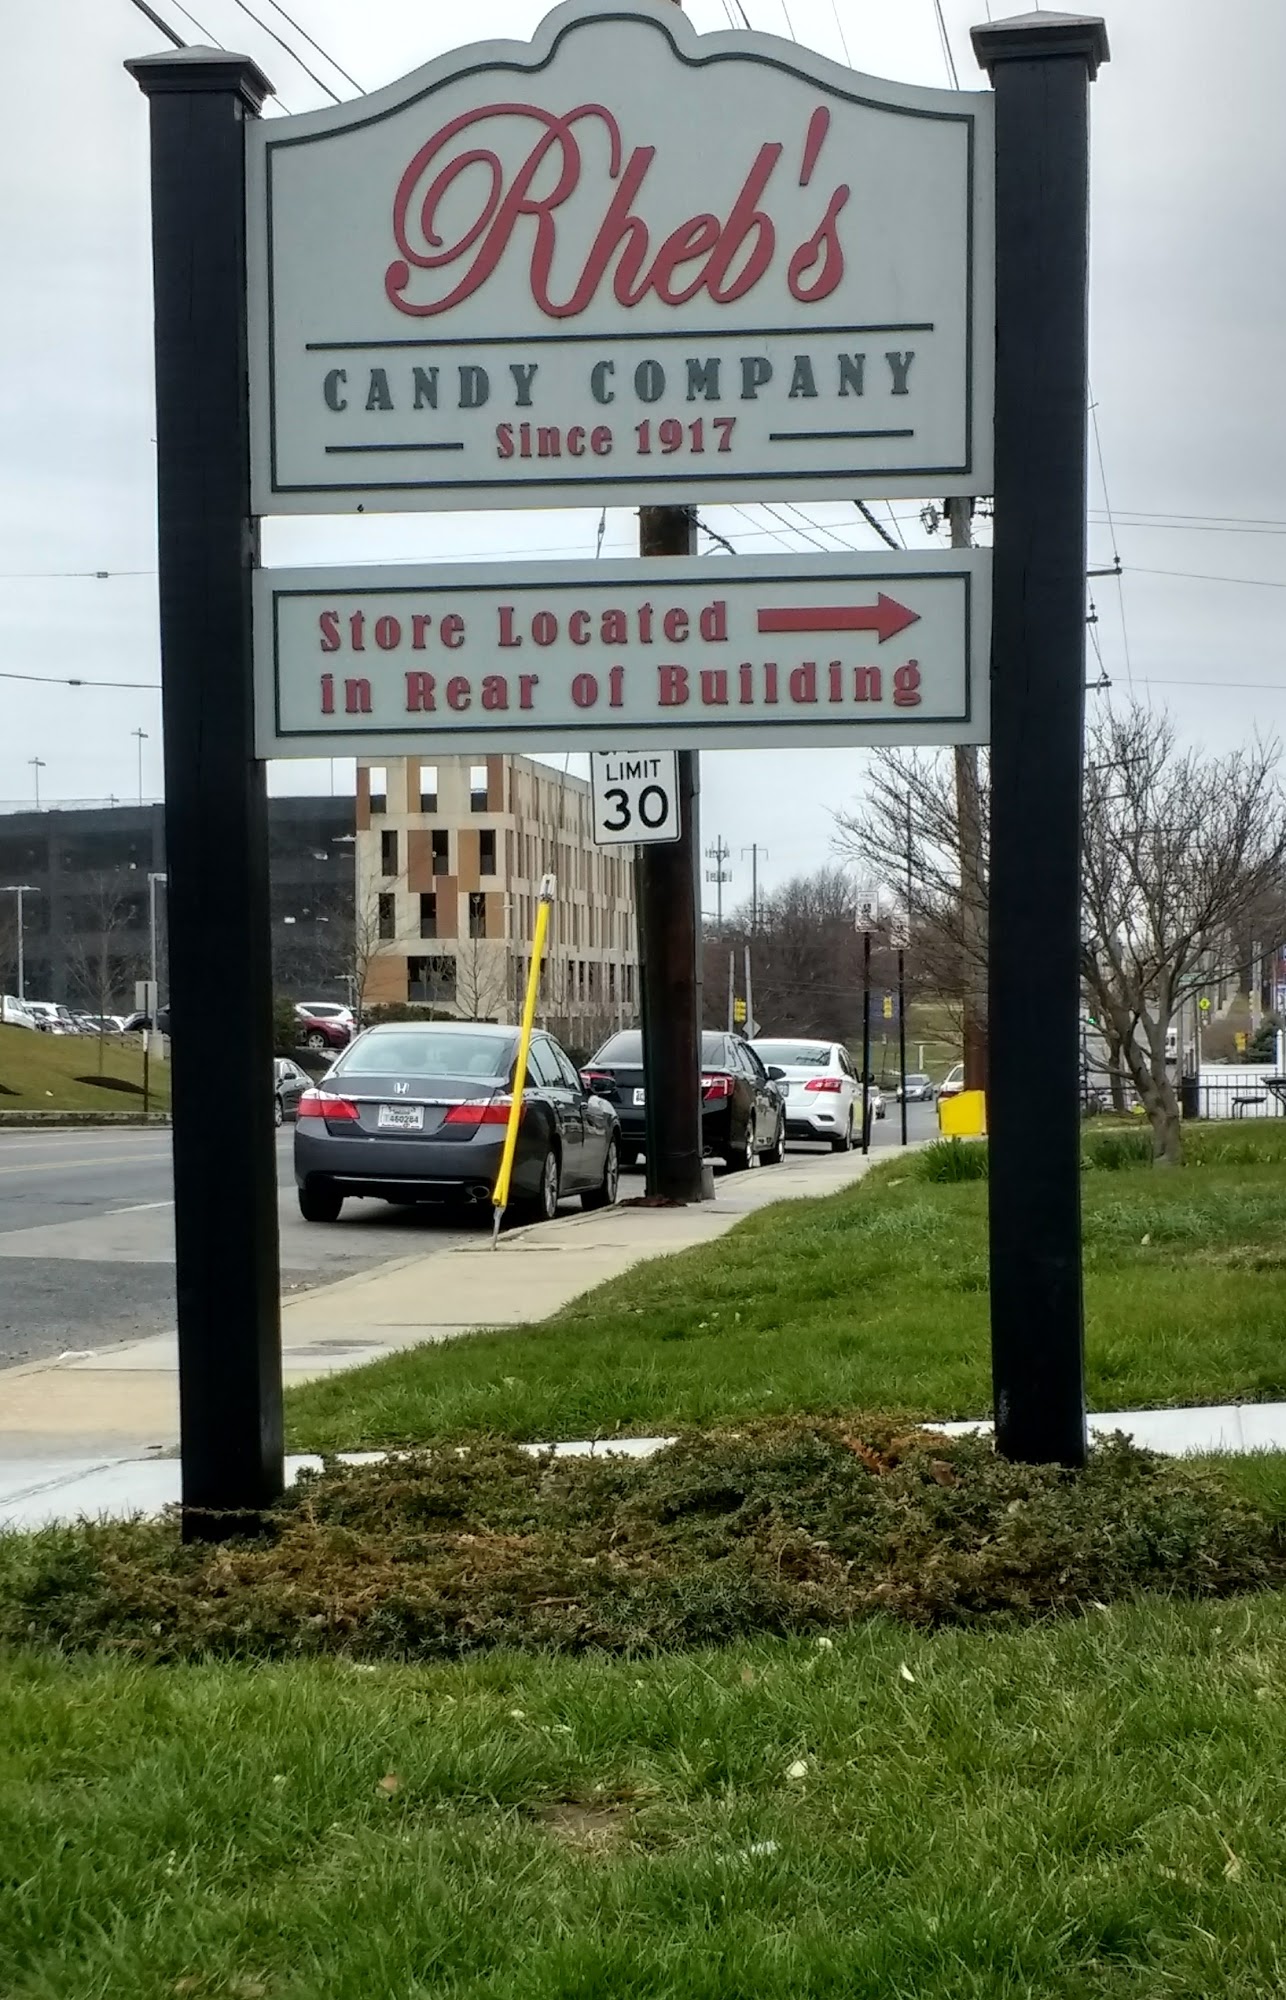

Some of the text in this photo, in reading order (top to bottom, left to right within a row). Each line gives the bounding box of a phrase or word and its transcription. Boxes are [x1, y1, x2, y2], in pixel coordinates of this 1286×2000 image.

[385, 103, 850, 318] Rheb's
[322, 351, 916, 411] CANDY COMPANY
[496, 417, 737, 458] Since 1917
[319, 600, 729, 652] Store Located
[321, 658, 922, 714] in Rear of Building
[606, 759, 661, 781] LIMIT
[602, 785, 669, 831] 30
